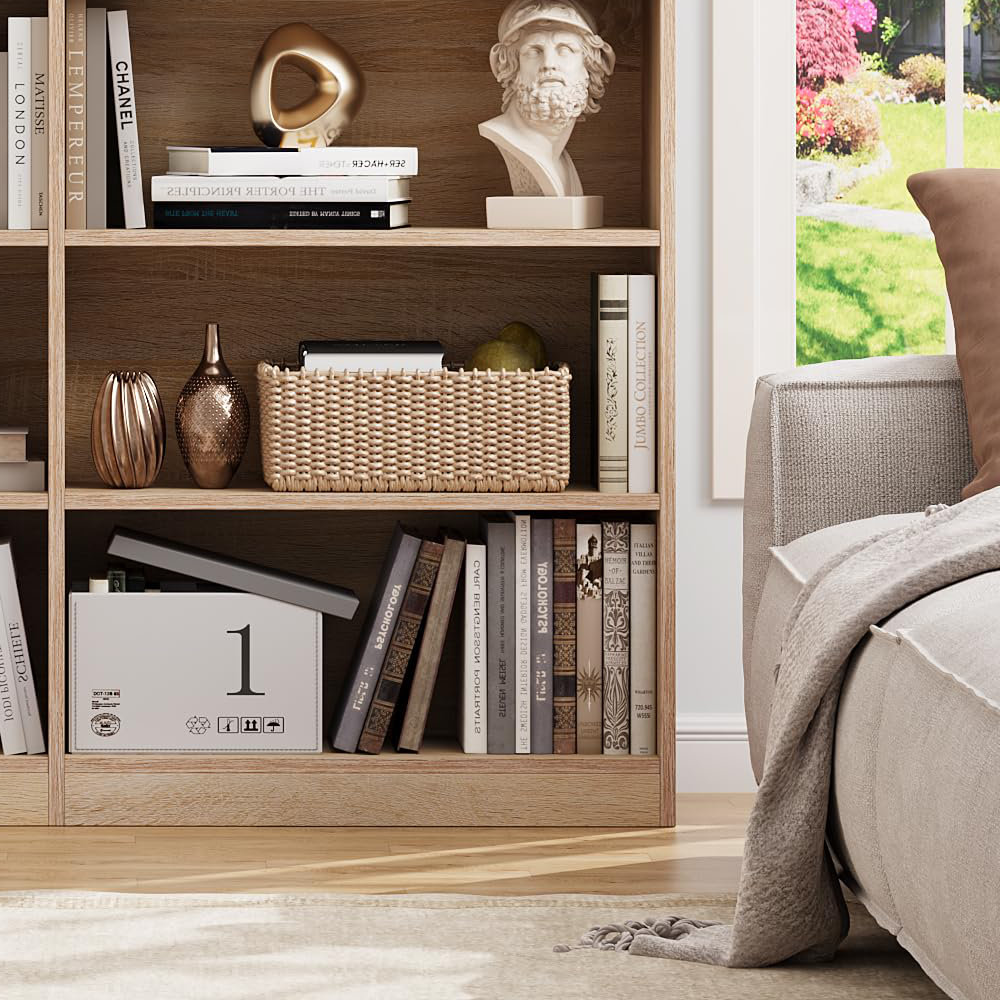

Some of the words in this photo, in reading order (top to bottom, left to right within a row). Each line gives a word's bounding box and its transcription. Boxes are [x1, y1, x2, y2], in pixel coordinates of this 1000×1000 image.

[15, 83, 26, 165] LONDON
[34, 72, 45, 135] MATISSE
[68, 49, 84, 204] LEMPEREUR
[115, 61, 134, 130] CHANEL
[633, 321, 647, 402] COLLECTION
[633, 406, 649, 449] JUMBO
[226, 623, 266, 696] 1
